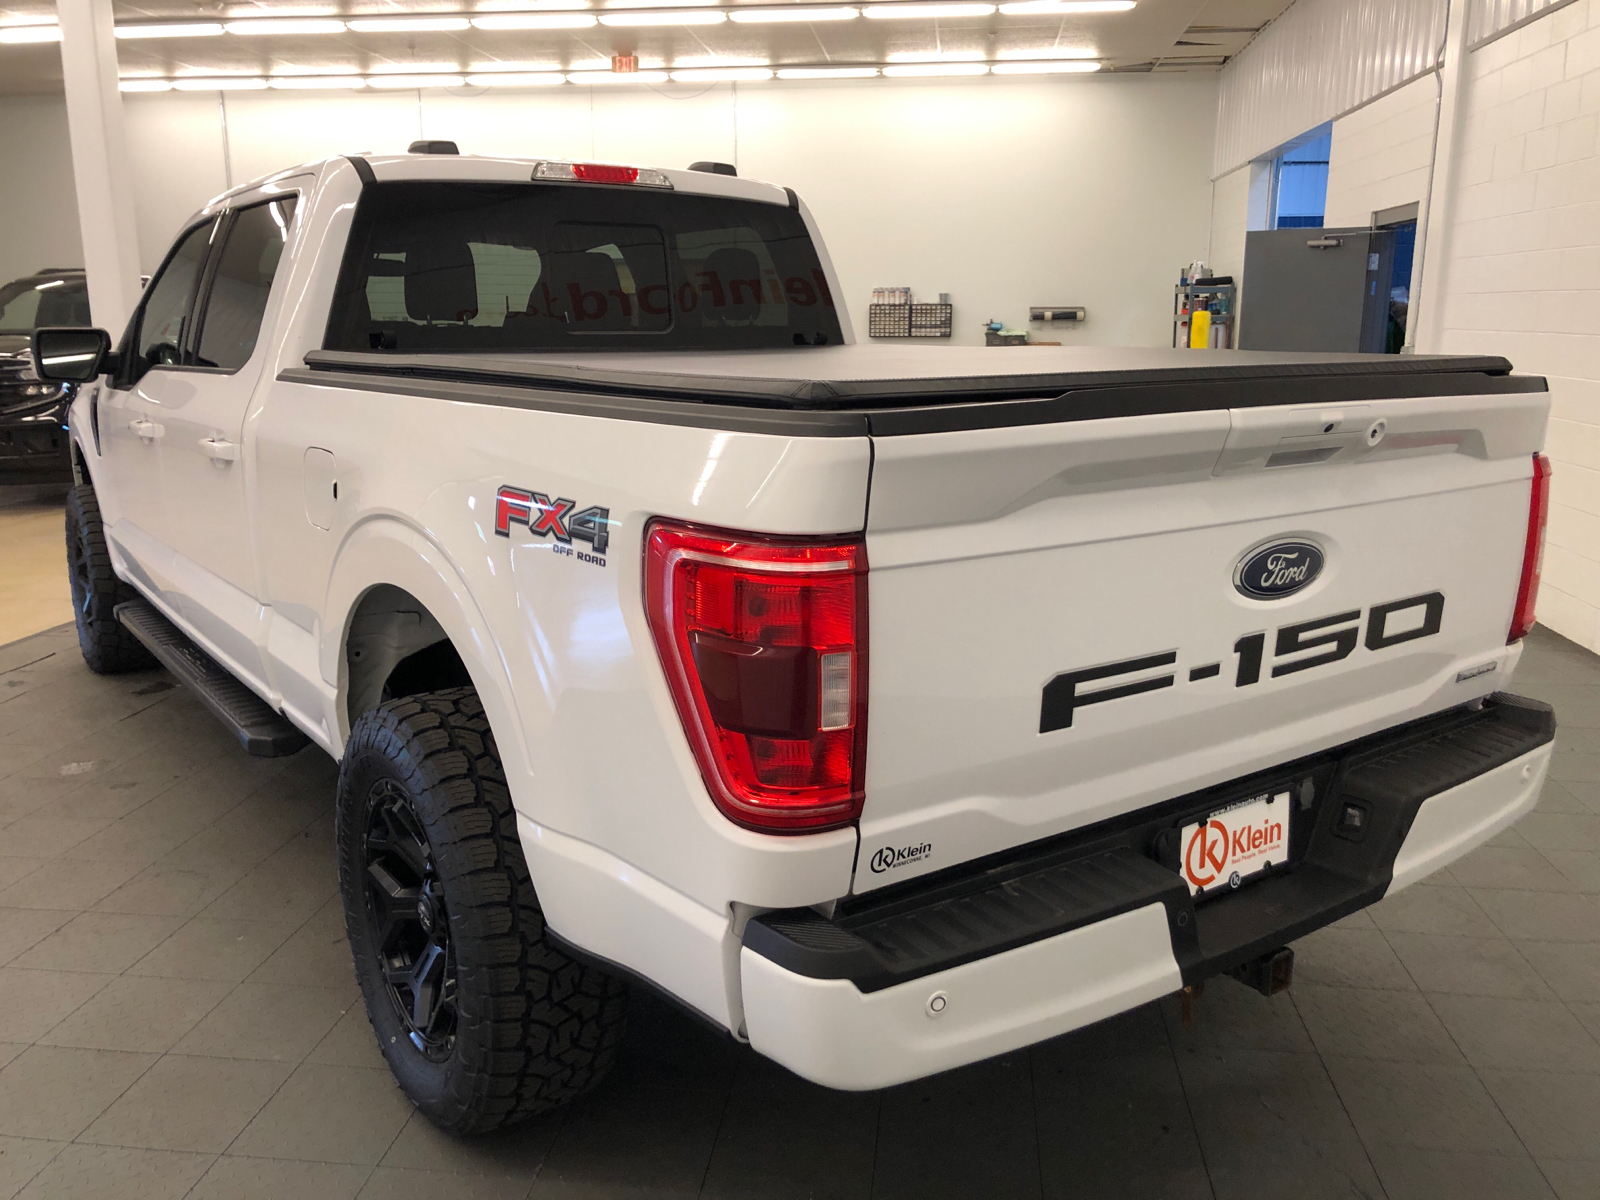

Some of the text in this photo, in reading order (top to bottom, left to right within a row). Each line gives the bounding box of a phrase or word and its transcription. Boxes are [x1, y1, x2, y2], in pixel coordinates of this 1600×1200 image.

[615, 56, 634, 72] EXIT
[495, 484, 610, 556] FX4
[552, 543, 607, 568] OFF ROAD
[1260, 552, 1310, 588] Ford
[1039, 591, 1446, 734] F-150
[896, 842, 932, 860] Klein
[1231, 819, 1282, 857] Klein
